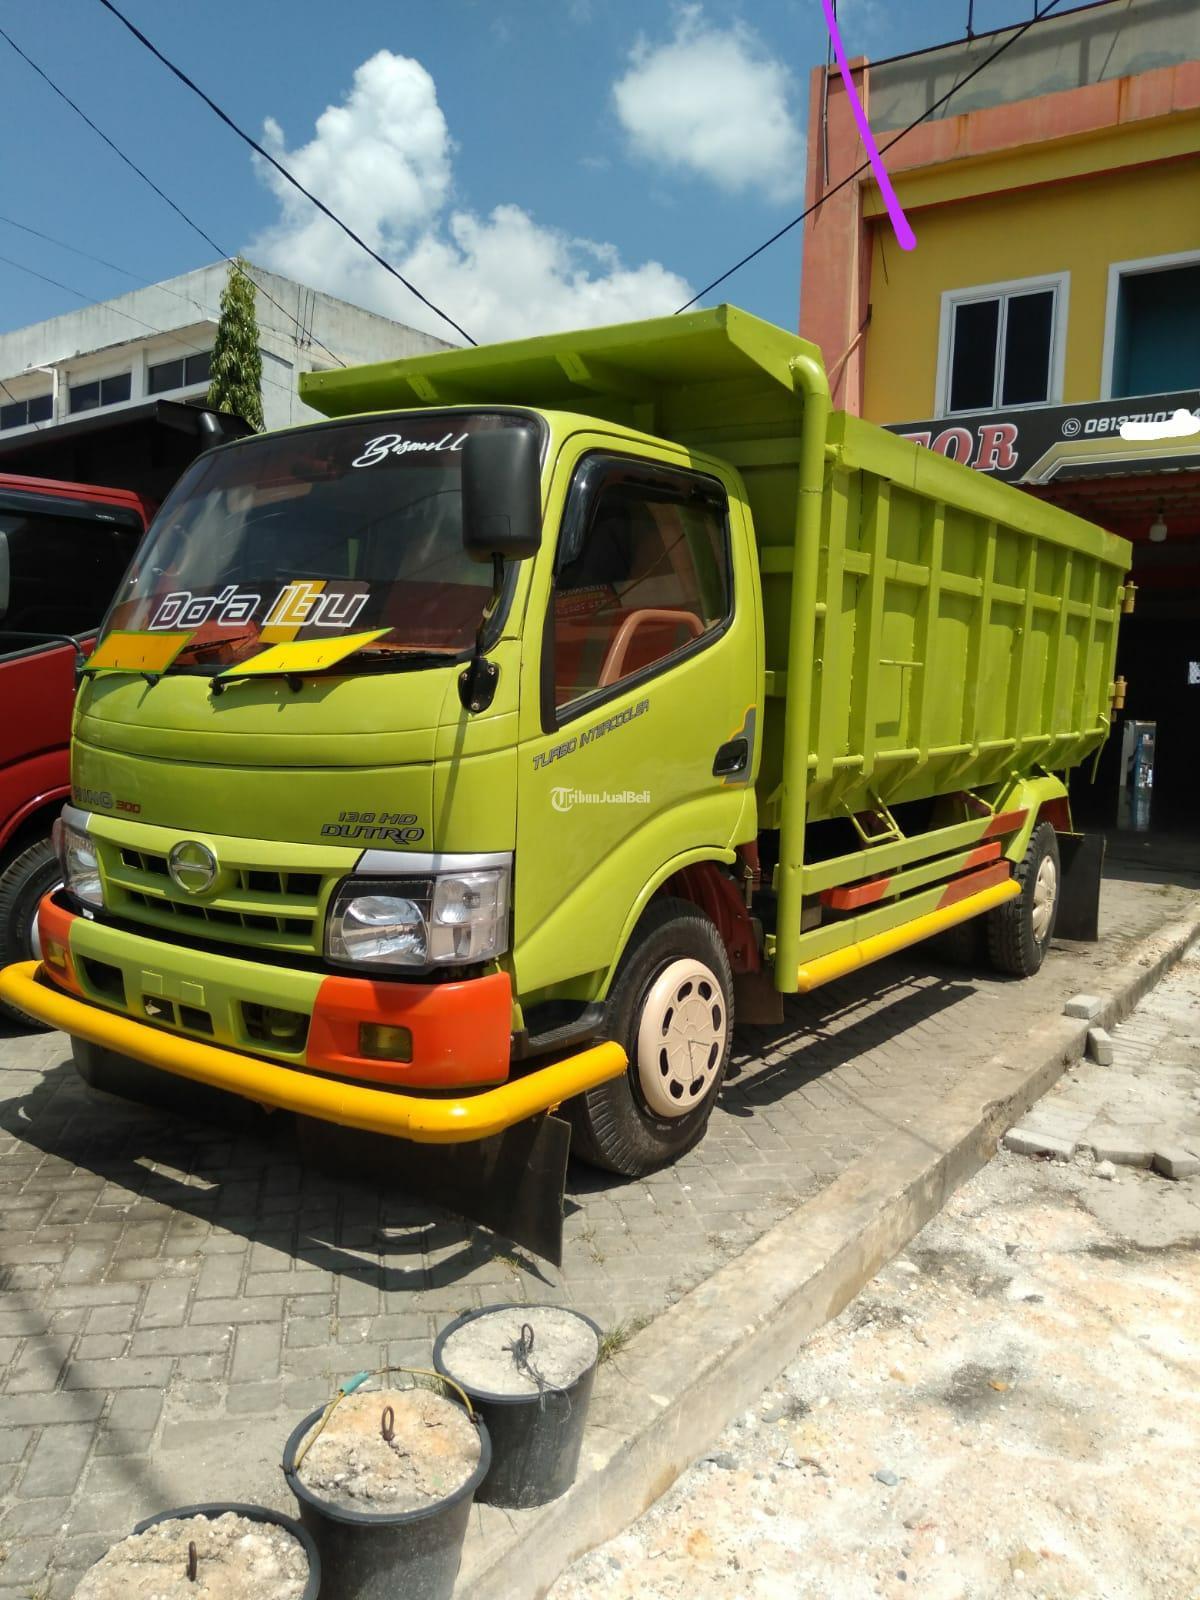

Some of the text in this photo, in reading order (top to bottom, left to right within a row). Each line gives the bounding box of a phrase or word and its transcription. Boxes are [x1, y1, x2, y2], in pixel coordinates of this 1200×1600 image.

[148, 585, 261, 630] Do'a
[532, 699, 650, 771] TURBO INTERCOOLER
[320, 823, 425, 845] DUTRO
[338, 811, 418, 825] 130 HD
